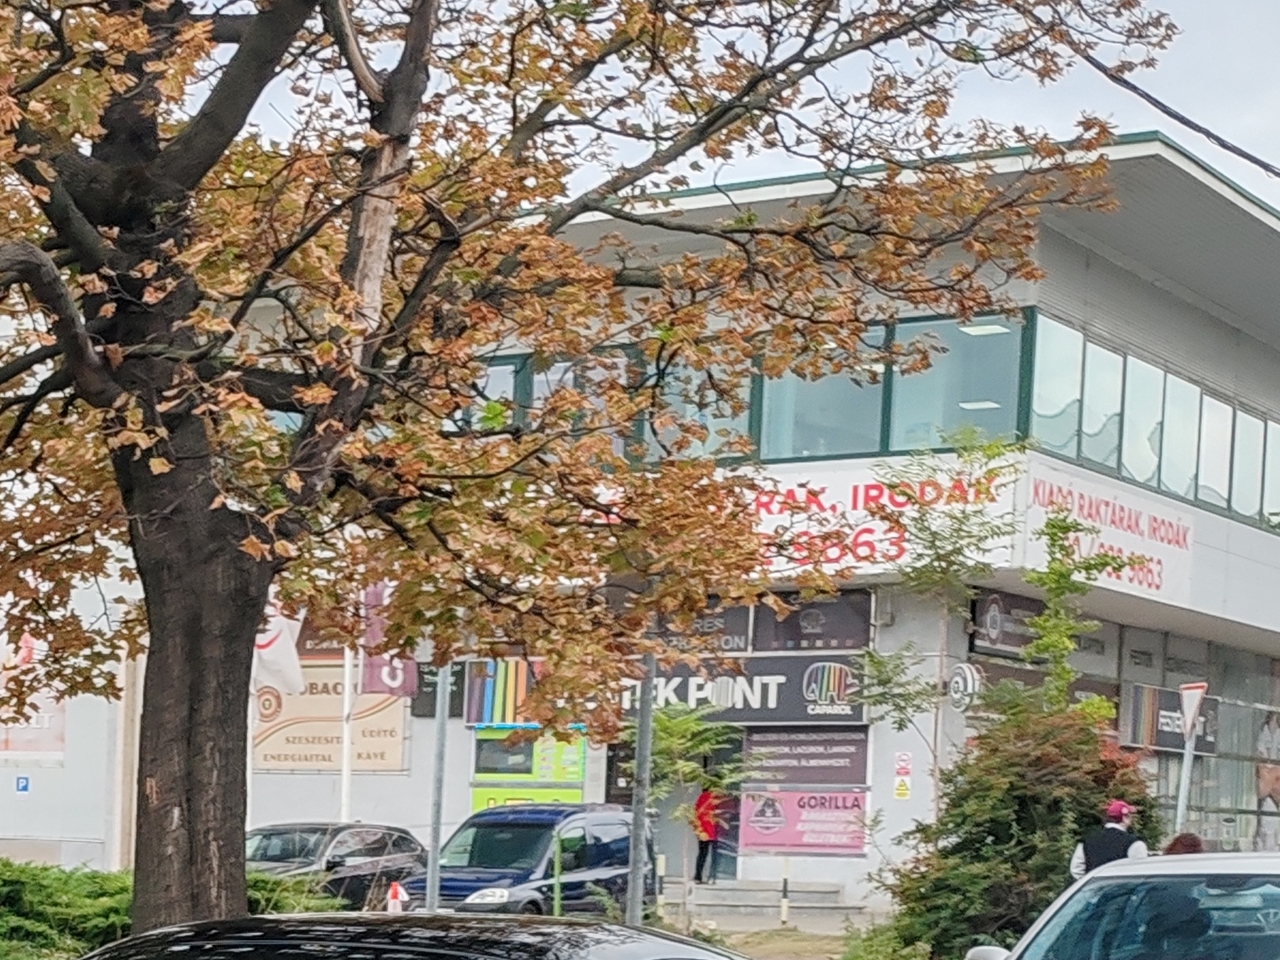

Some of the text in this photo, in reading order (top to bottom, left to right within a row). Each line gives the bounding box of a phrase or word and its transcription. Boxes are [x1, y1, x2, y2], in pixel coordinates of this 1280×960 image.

[687, 674, 787, 710] PONT
[284, 735, 354, 745] SZESZESIT
[797, 795, 862, 810] GORILLA
